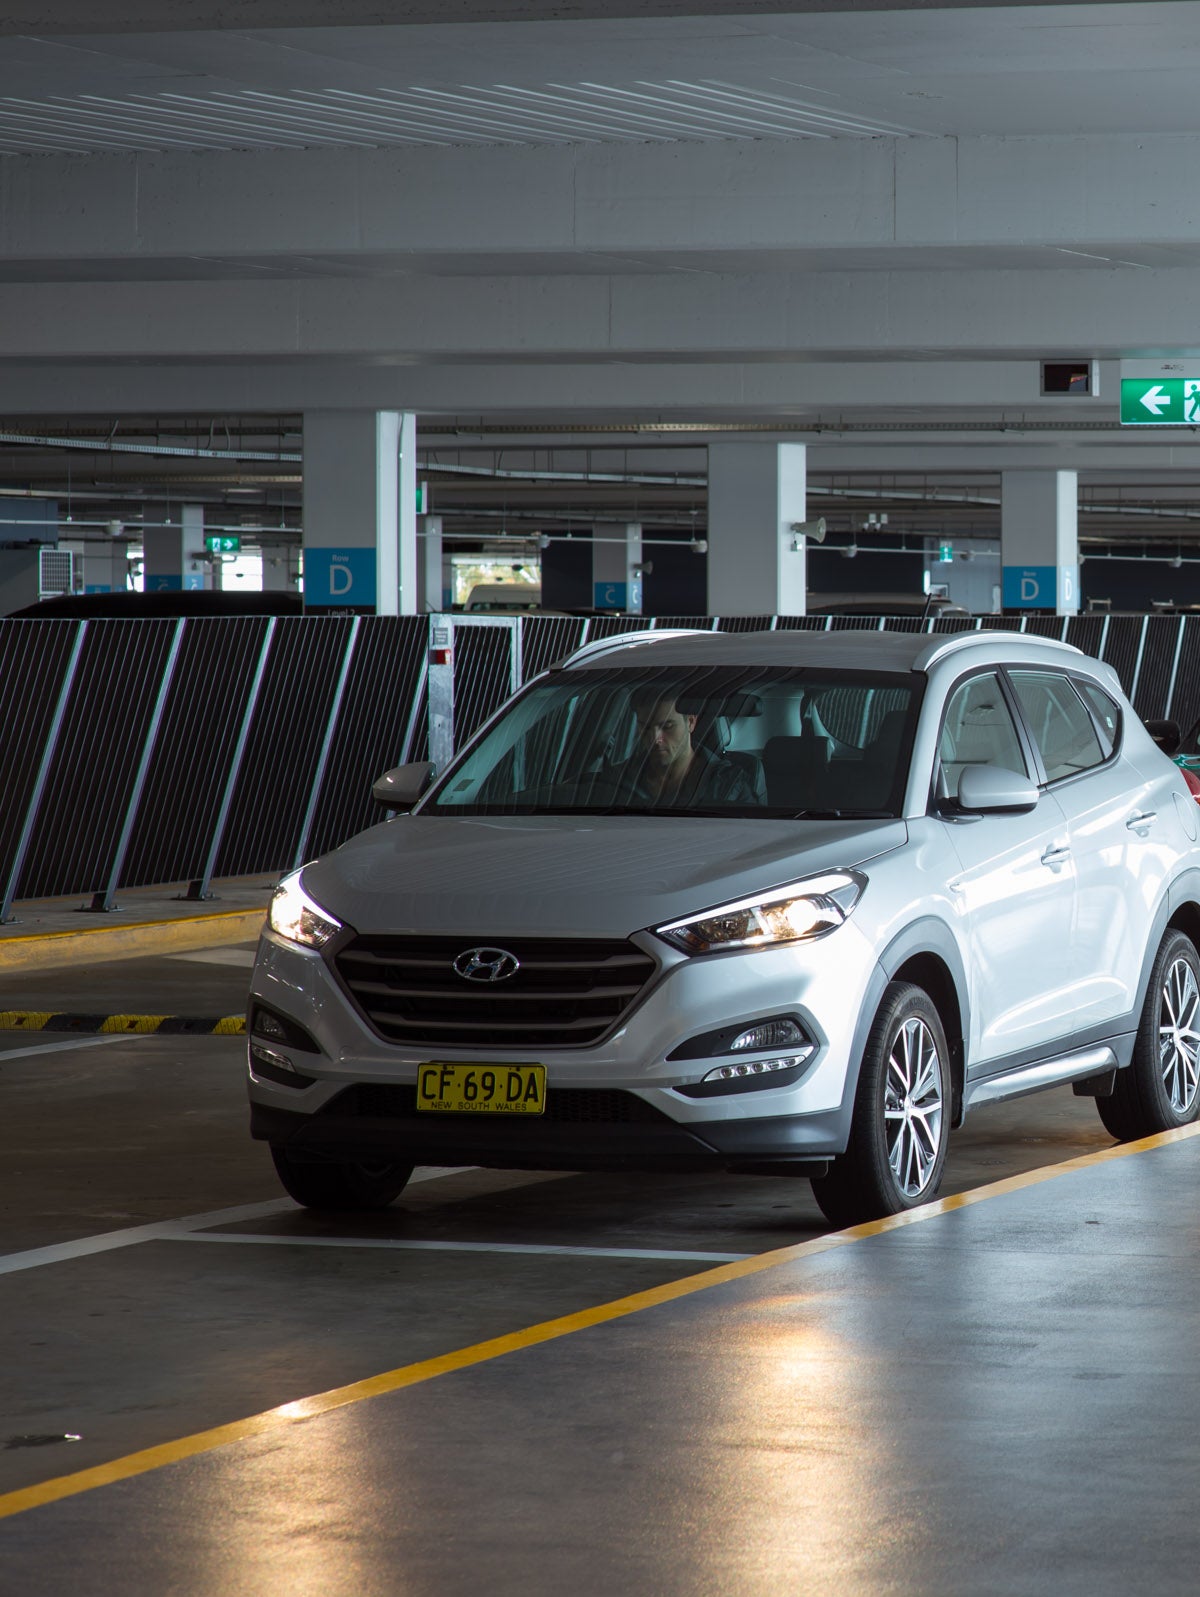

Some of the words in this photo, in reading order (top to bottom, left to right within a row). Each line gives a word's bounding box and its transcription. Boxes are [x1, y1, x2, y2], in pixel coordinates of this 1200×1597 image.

[331, 554, 350, 562] Row
[329, 564, 354, 596] D
[1020, 578, 1040, 601] D
[605, 588, 616, 604] C
[422, 1069, 455, 1101] CF
[463, 1071, 496, 1102] 69
[506, 1071, 539, 1103] DA
[431, 1101, 453, 1110] NEW
[457, 1102, 490, 1111] SOUTH
[495, 1102, 527, 1112] WALES
